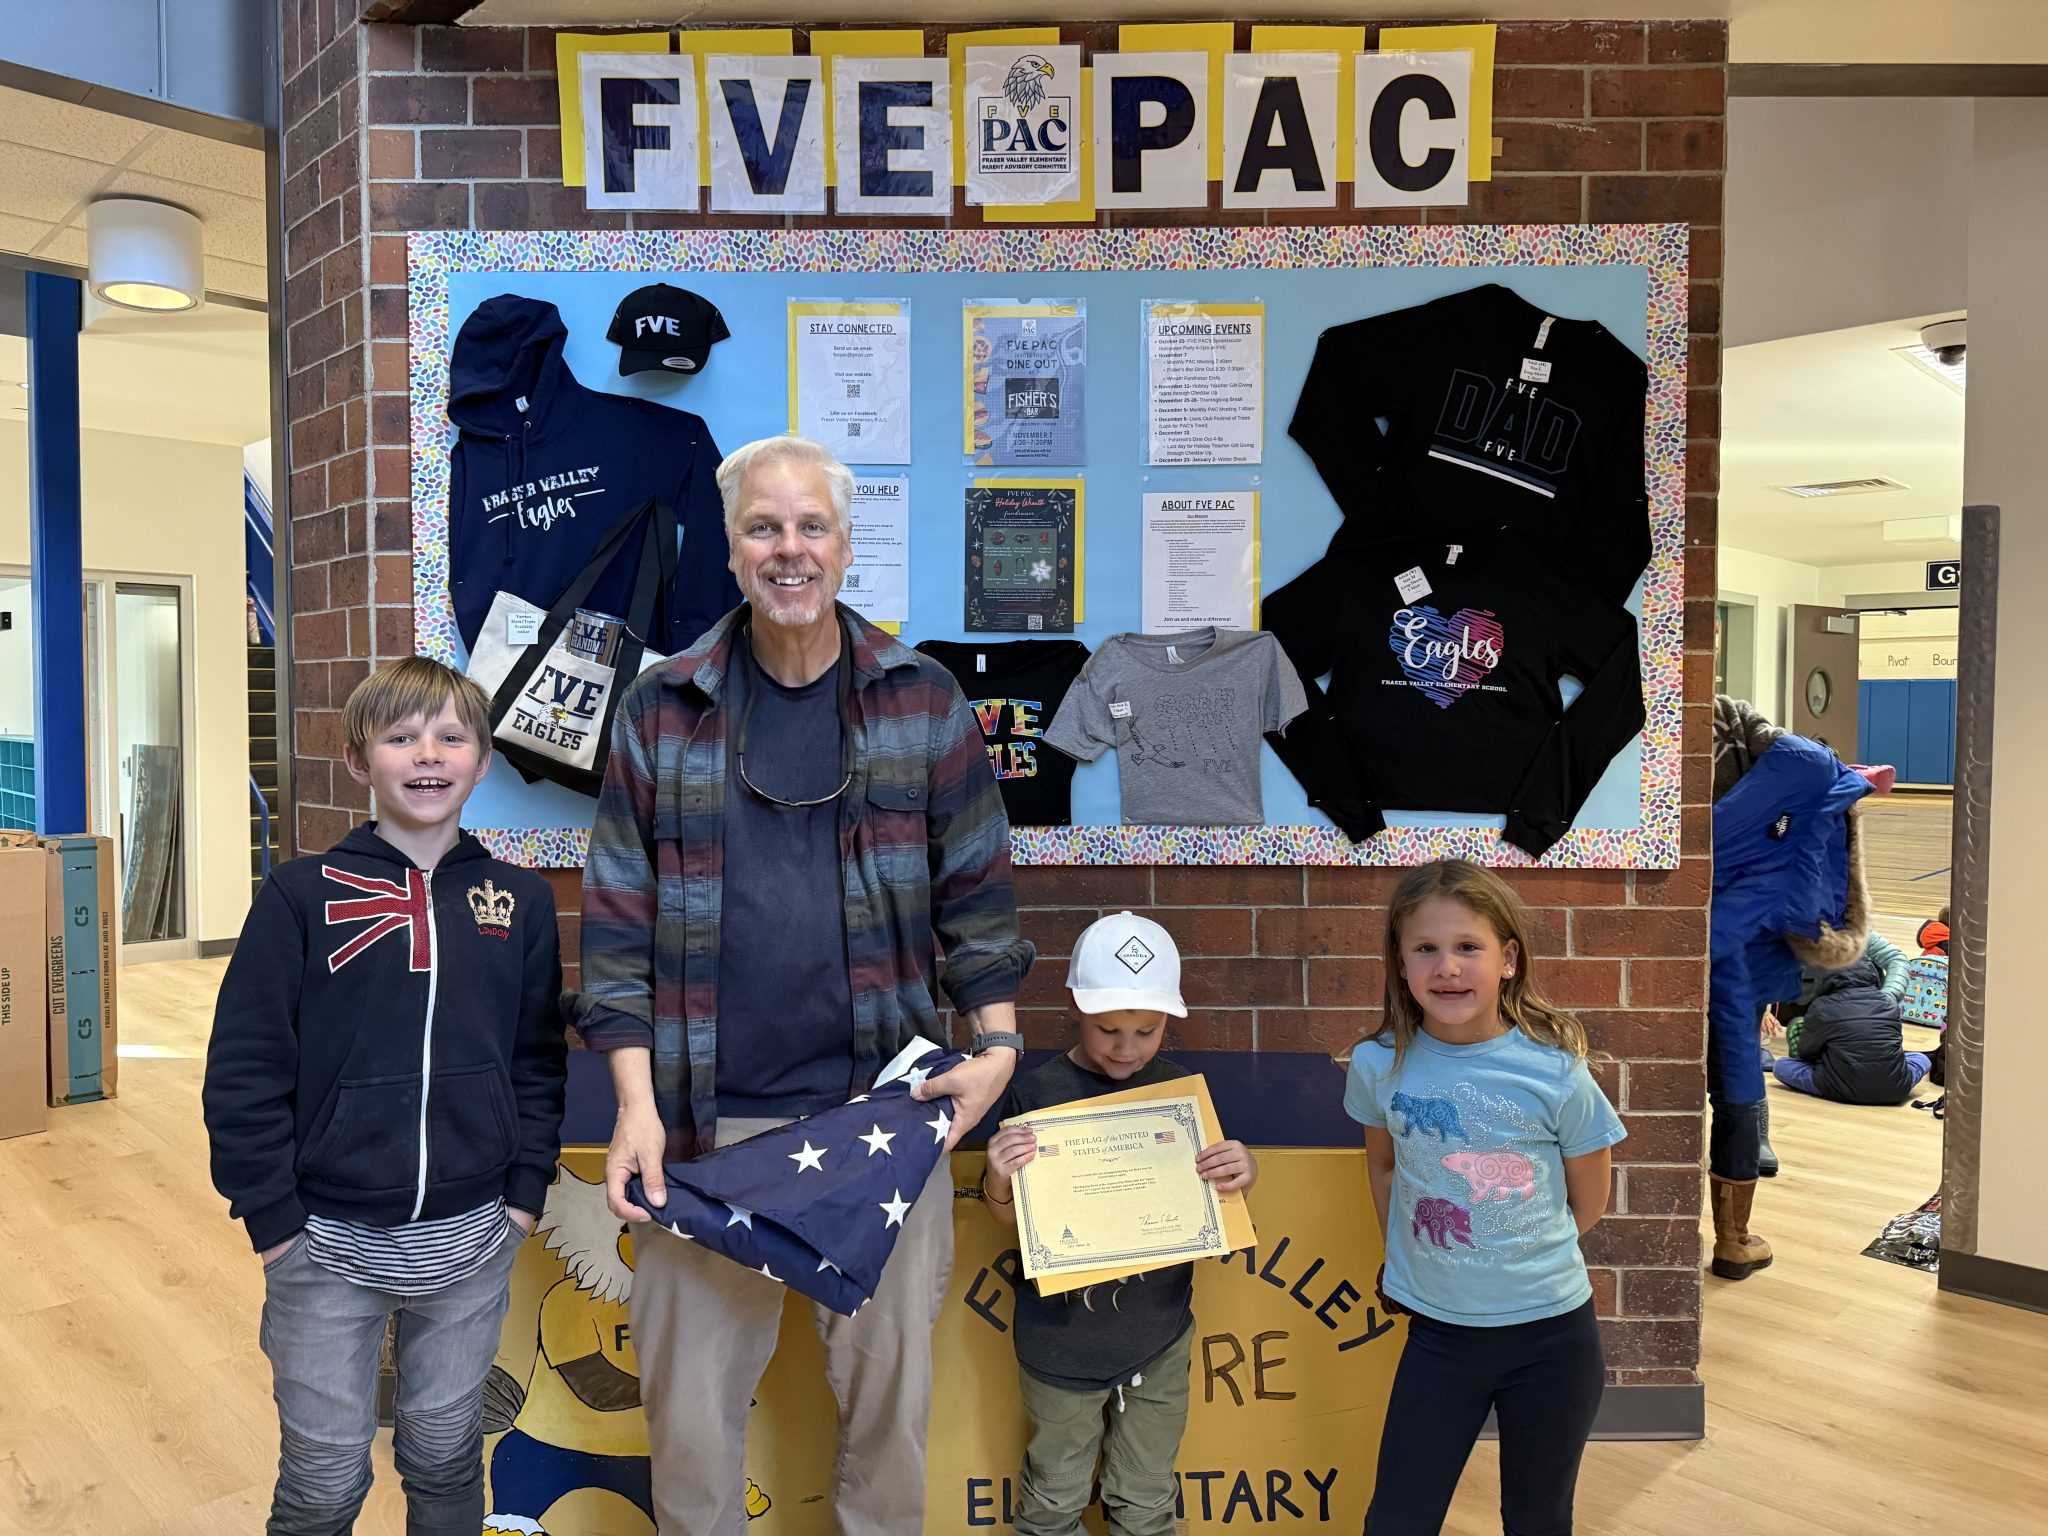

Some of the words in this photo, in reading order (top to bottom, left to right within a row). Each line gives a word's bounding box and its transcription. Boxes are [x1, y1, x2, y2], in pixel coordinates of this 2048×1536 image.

[988, 105, 1059, 118] FVE
[602, 77, 934, 196] FVE
[1110, 74, 1456, 193] PAC
[982, 119, 1067, 151] PAC
[634, 315, 681, 339] FVE
[810, 323, 834, 333] STAY
[836, 323, 893, 333] CONNECTED
[1158, 324, 1212, 335] UPCOMING
[1215, 323, 1251, 334] EVENTS
[1007, 340, 1028, 350] FVE
[1031, 340, 1057, 350] PAC
[1007, 360, 1031, 369] DINE
[1034, 360, 1057, 369] OUT
[1505, 377, 1538, 400] FVE
[1008, 391, 1057, 409] FISHER'S
[1434, 368, 1582, 475] DAD
[1013, 431, 1048, 439] NOVEMBER
[1484, 441, 1516, 461] FVE
[482, 483, 537, 513] FRASER
[538, 466, 600, 494] VALLEY
[856, 485, 875, 494] YOU
[878, 485, 899, 495] HELP
[517, 496, 576, 531] Eagles
[994, 498, 1021, 509] Holiday
[1022, 498, 1046, 506] Wreath
[1161, 500, 1193, 510] ABOUT
[1195, 500, 1213, 510] FVE
[1215, 500, 1235, 509] PAC
[1937, 566, 1960, 587] G
[574, 621, 609, 642] FVE
[571, 635, 607, 655] GRANDMA
[1393, 609, 1501, 680] Eagles
[1888, 655, 1909, 666] Pivot
[527, 664, 605, 716] FVE
[1435, 681, 1481, 690] ELEMENTARY
[968, 698, 1043, 738] VE
[511, 713, 583, 751] EAGLES
[985, 741, 1038, 780] LES
[1202, 758, 1232, 774] FVE
[48, 847, 55, 855] UP
[74, 905, 89, 928] C5
[477, 927, 510, 942] LONDON
[2, 967, 11, 978] UP
[50, 935, 65, 1000] EVERGREENS
[2, 978, 11, 1002] SIDE
[2, 1003, 11, 1026] THIS
[53, 1001, 65, 1015] CUT
[78, 1017, 92, 1040] C5
[1064, 1139, 1081, 1147] THE
[1081, 1136, 1103, 1145] FLAG
[1118, 1131, 1149, 1141] UNITED
[1072, 1147, 1101, 1157] STATES
[1108, 1142, 1144, 1153] AMERICA
[1207, 1222, 1396, 1352] ALLEY
